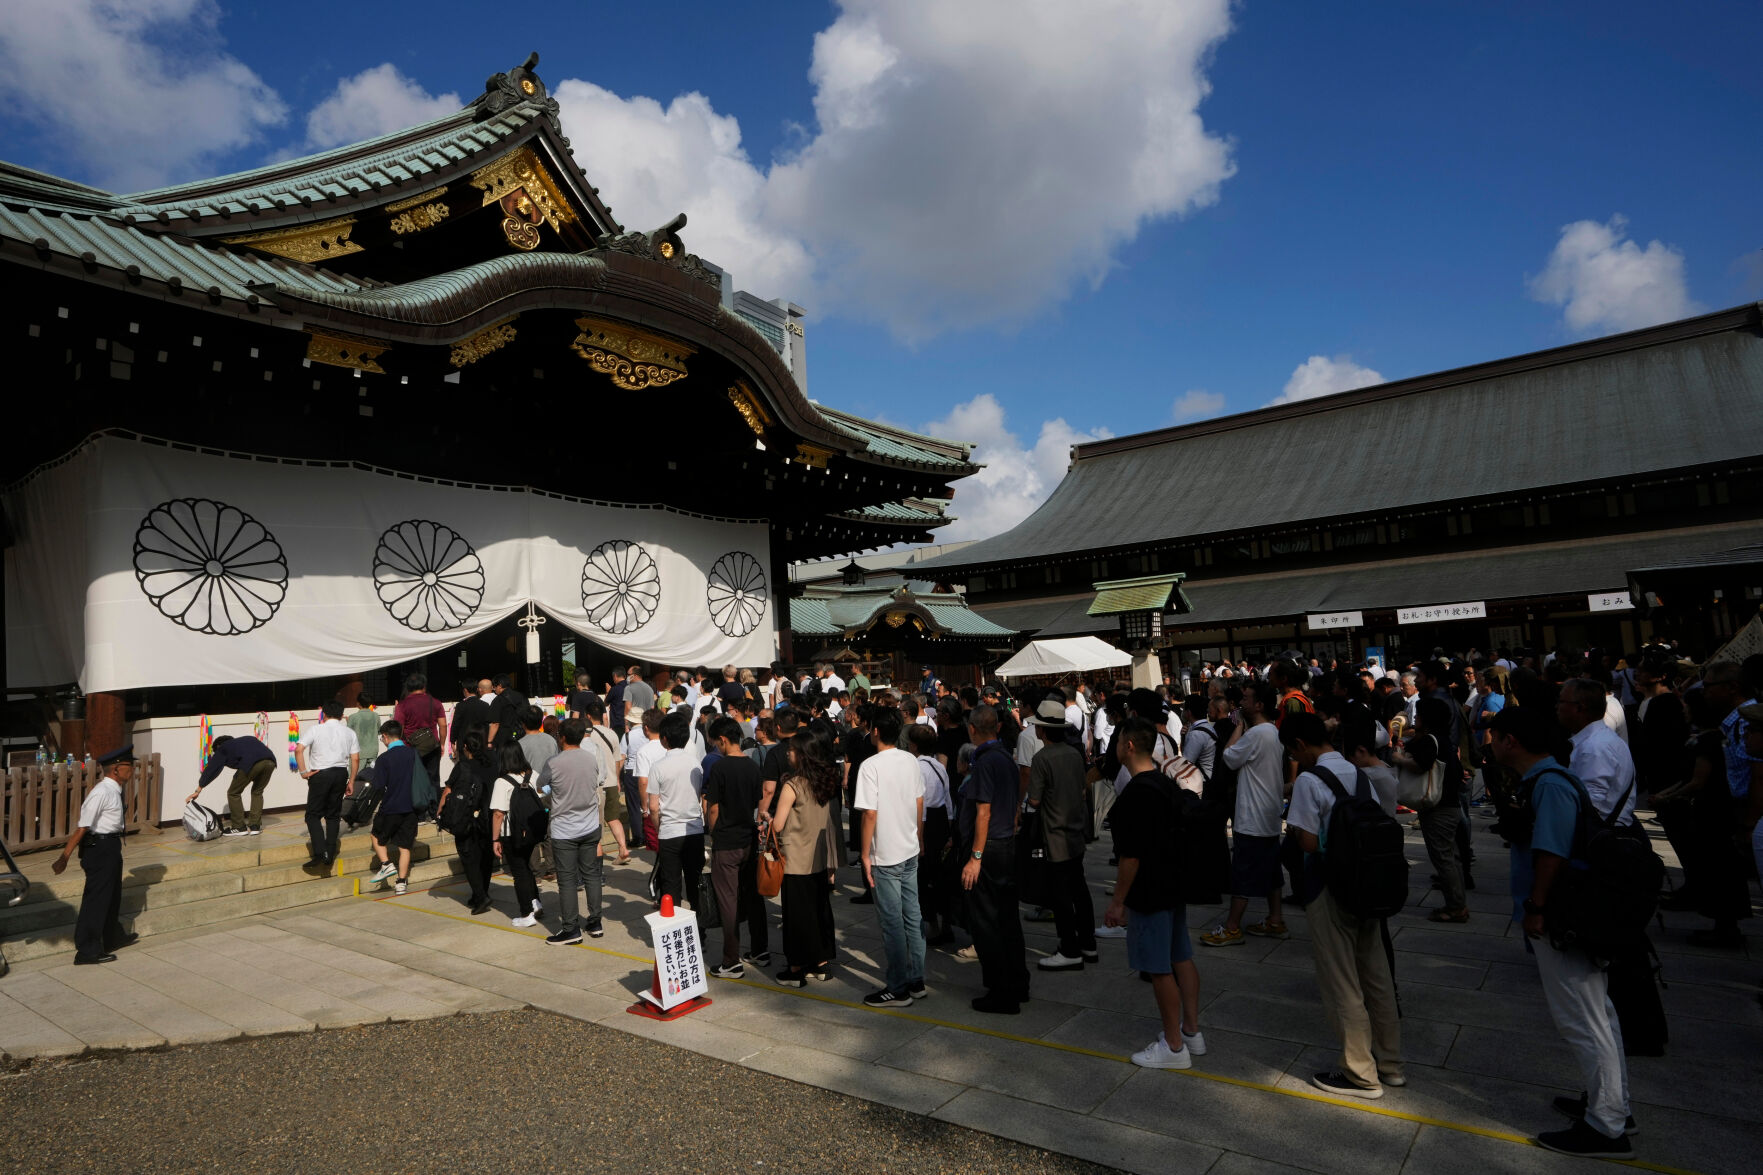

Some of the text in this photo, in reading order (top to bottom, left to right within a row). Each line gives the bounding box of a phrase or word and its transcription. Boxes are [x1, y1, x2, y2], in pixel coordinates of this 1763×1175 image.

[661, 932, 677, 975] び下さい。
[672, 929, 690, 990] 列後方にお並
[684, 925, 701, 985] 御参拝の方は
